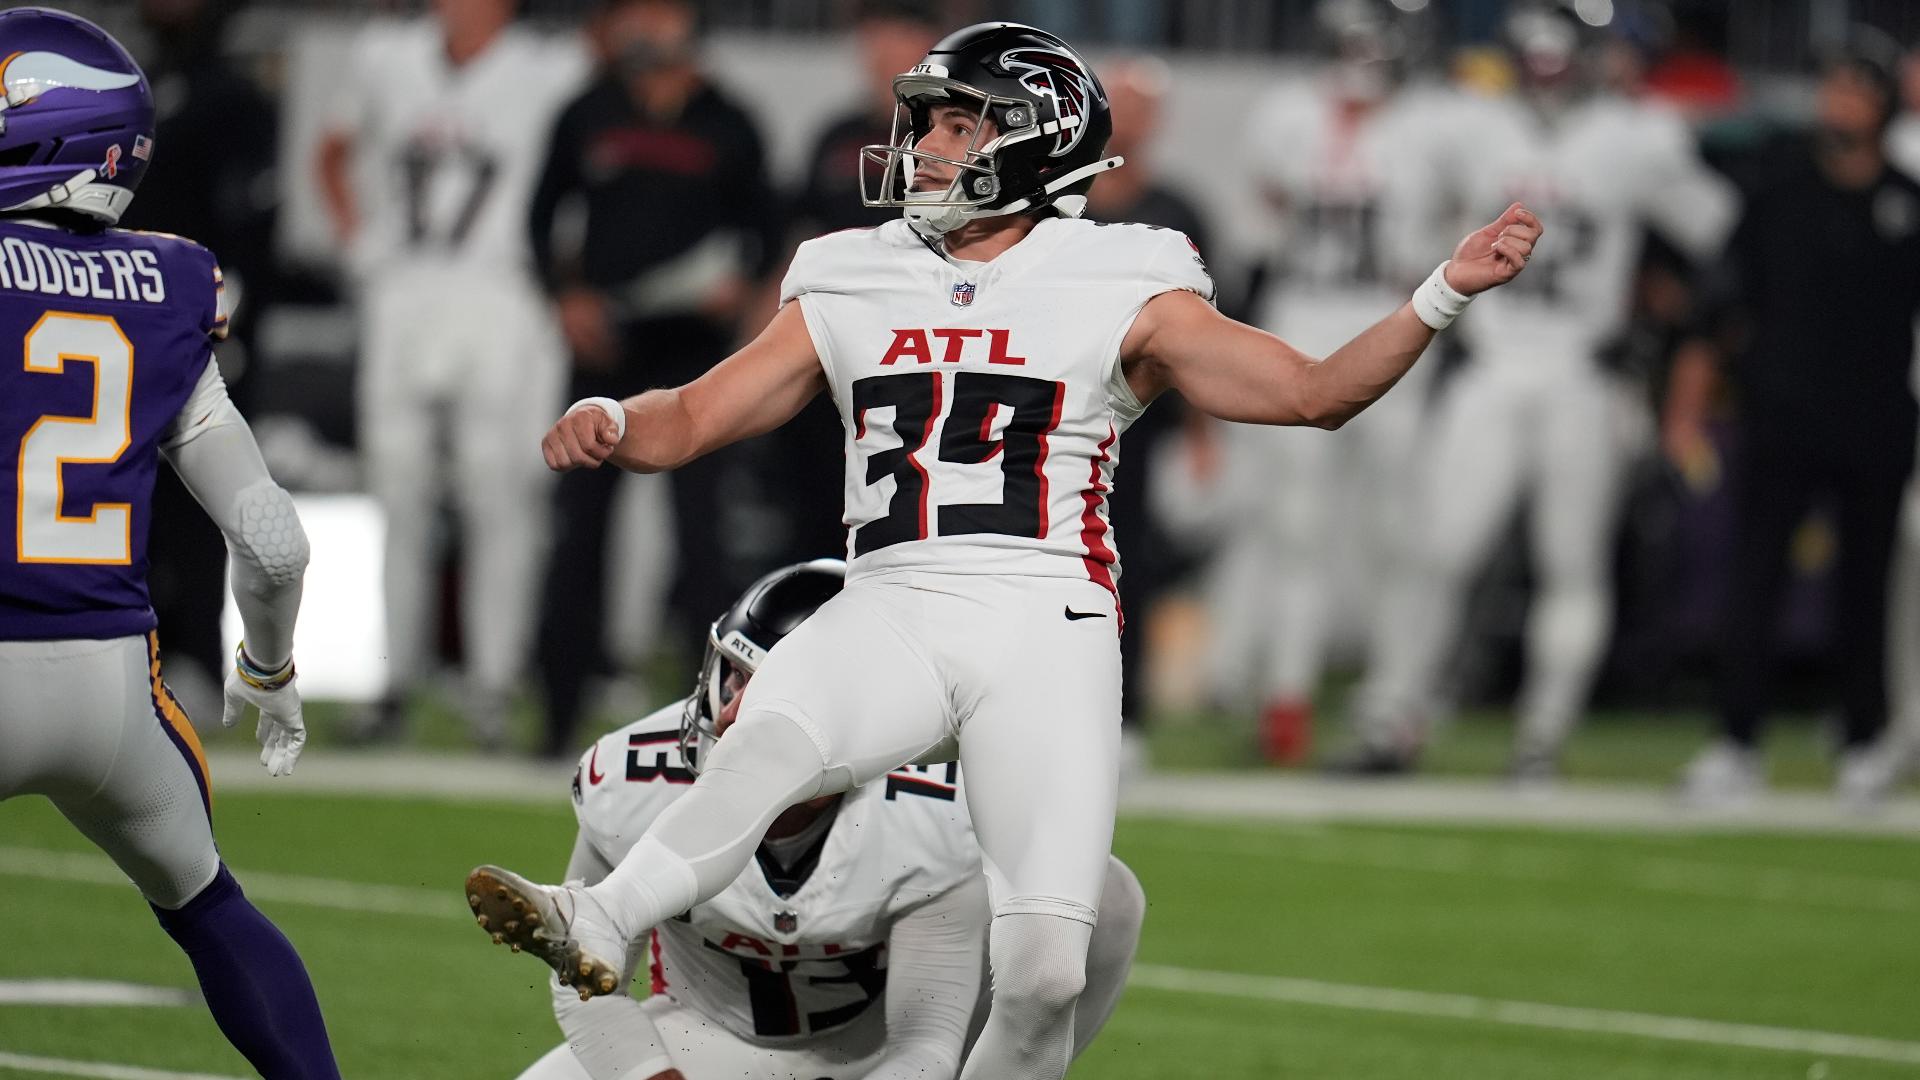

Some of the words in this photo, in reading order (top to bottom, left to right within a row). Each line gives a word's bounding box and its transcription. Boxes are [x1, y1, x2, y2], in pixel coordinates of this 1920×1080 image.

[912, 64, 932, 74] ATL
[879, 328, 1026, 366] ATL
[17, 310, 134, 565] 2
[851, 370, 1066, 559] 39
[731, 637, 754, 660] ATL
